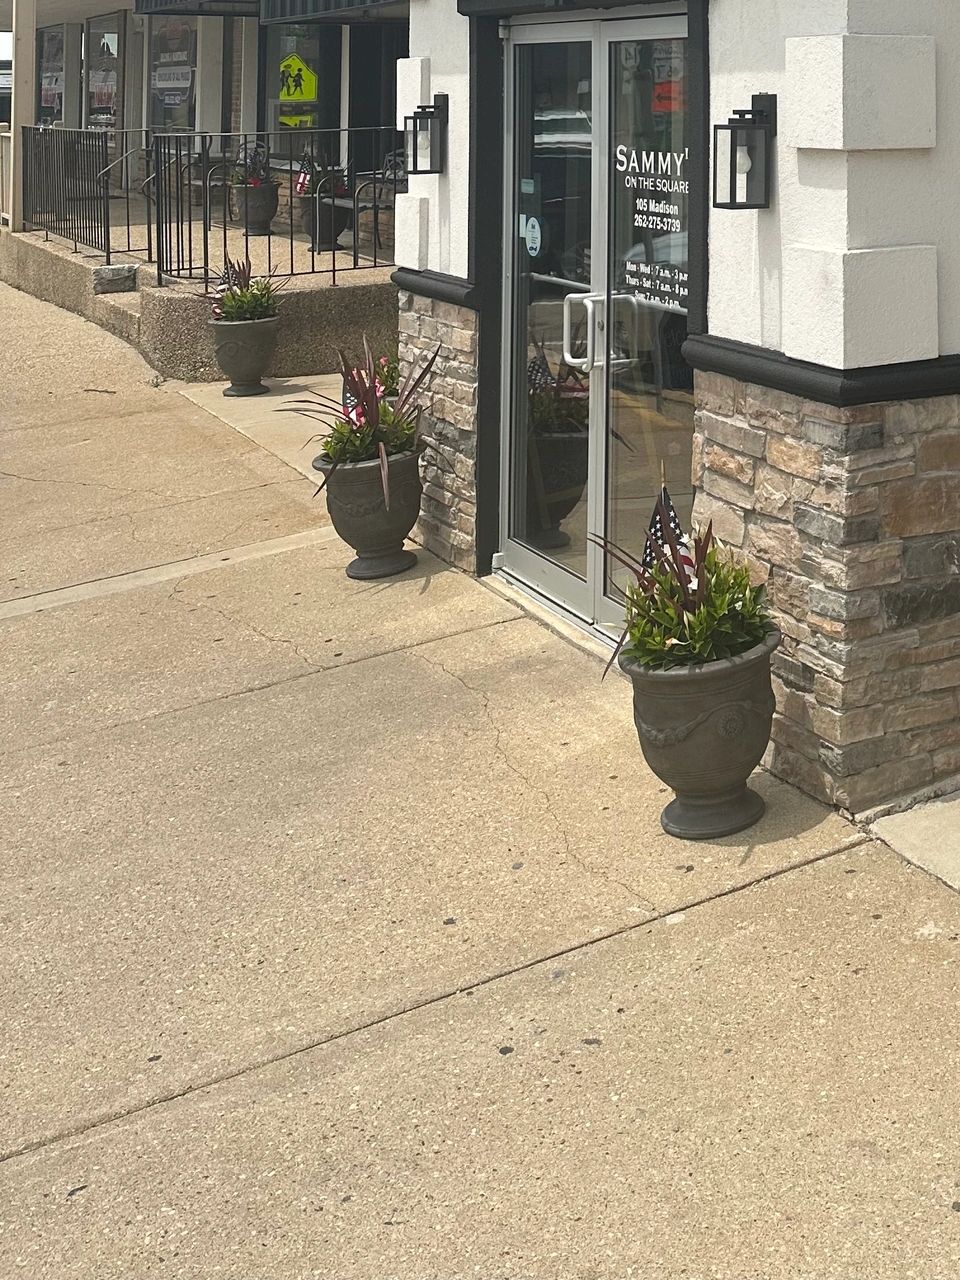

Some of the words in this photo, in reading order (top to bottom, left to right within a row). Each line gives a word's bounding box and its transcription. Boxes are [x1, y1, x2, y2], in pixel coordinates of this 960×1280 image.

[625, 175, 637, 189] ON
[638, 176, 655, 191] THE
[656, 179, 689, 194] SQUARE
[635, 197, 648, 212] 105
[649, 199, 679, 216] Madison
[634, 213, 681, 233] 262-275-3739
